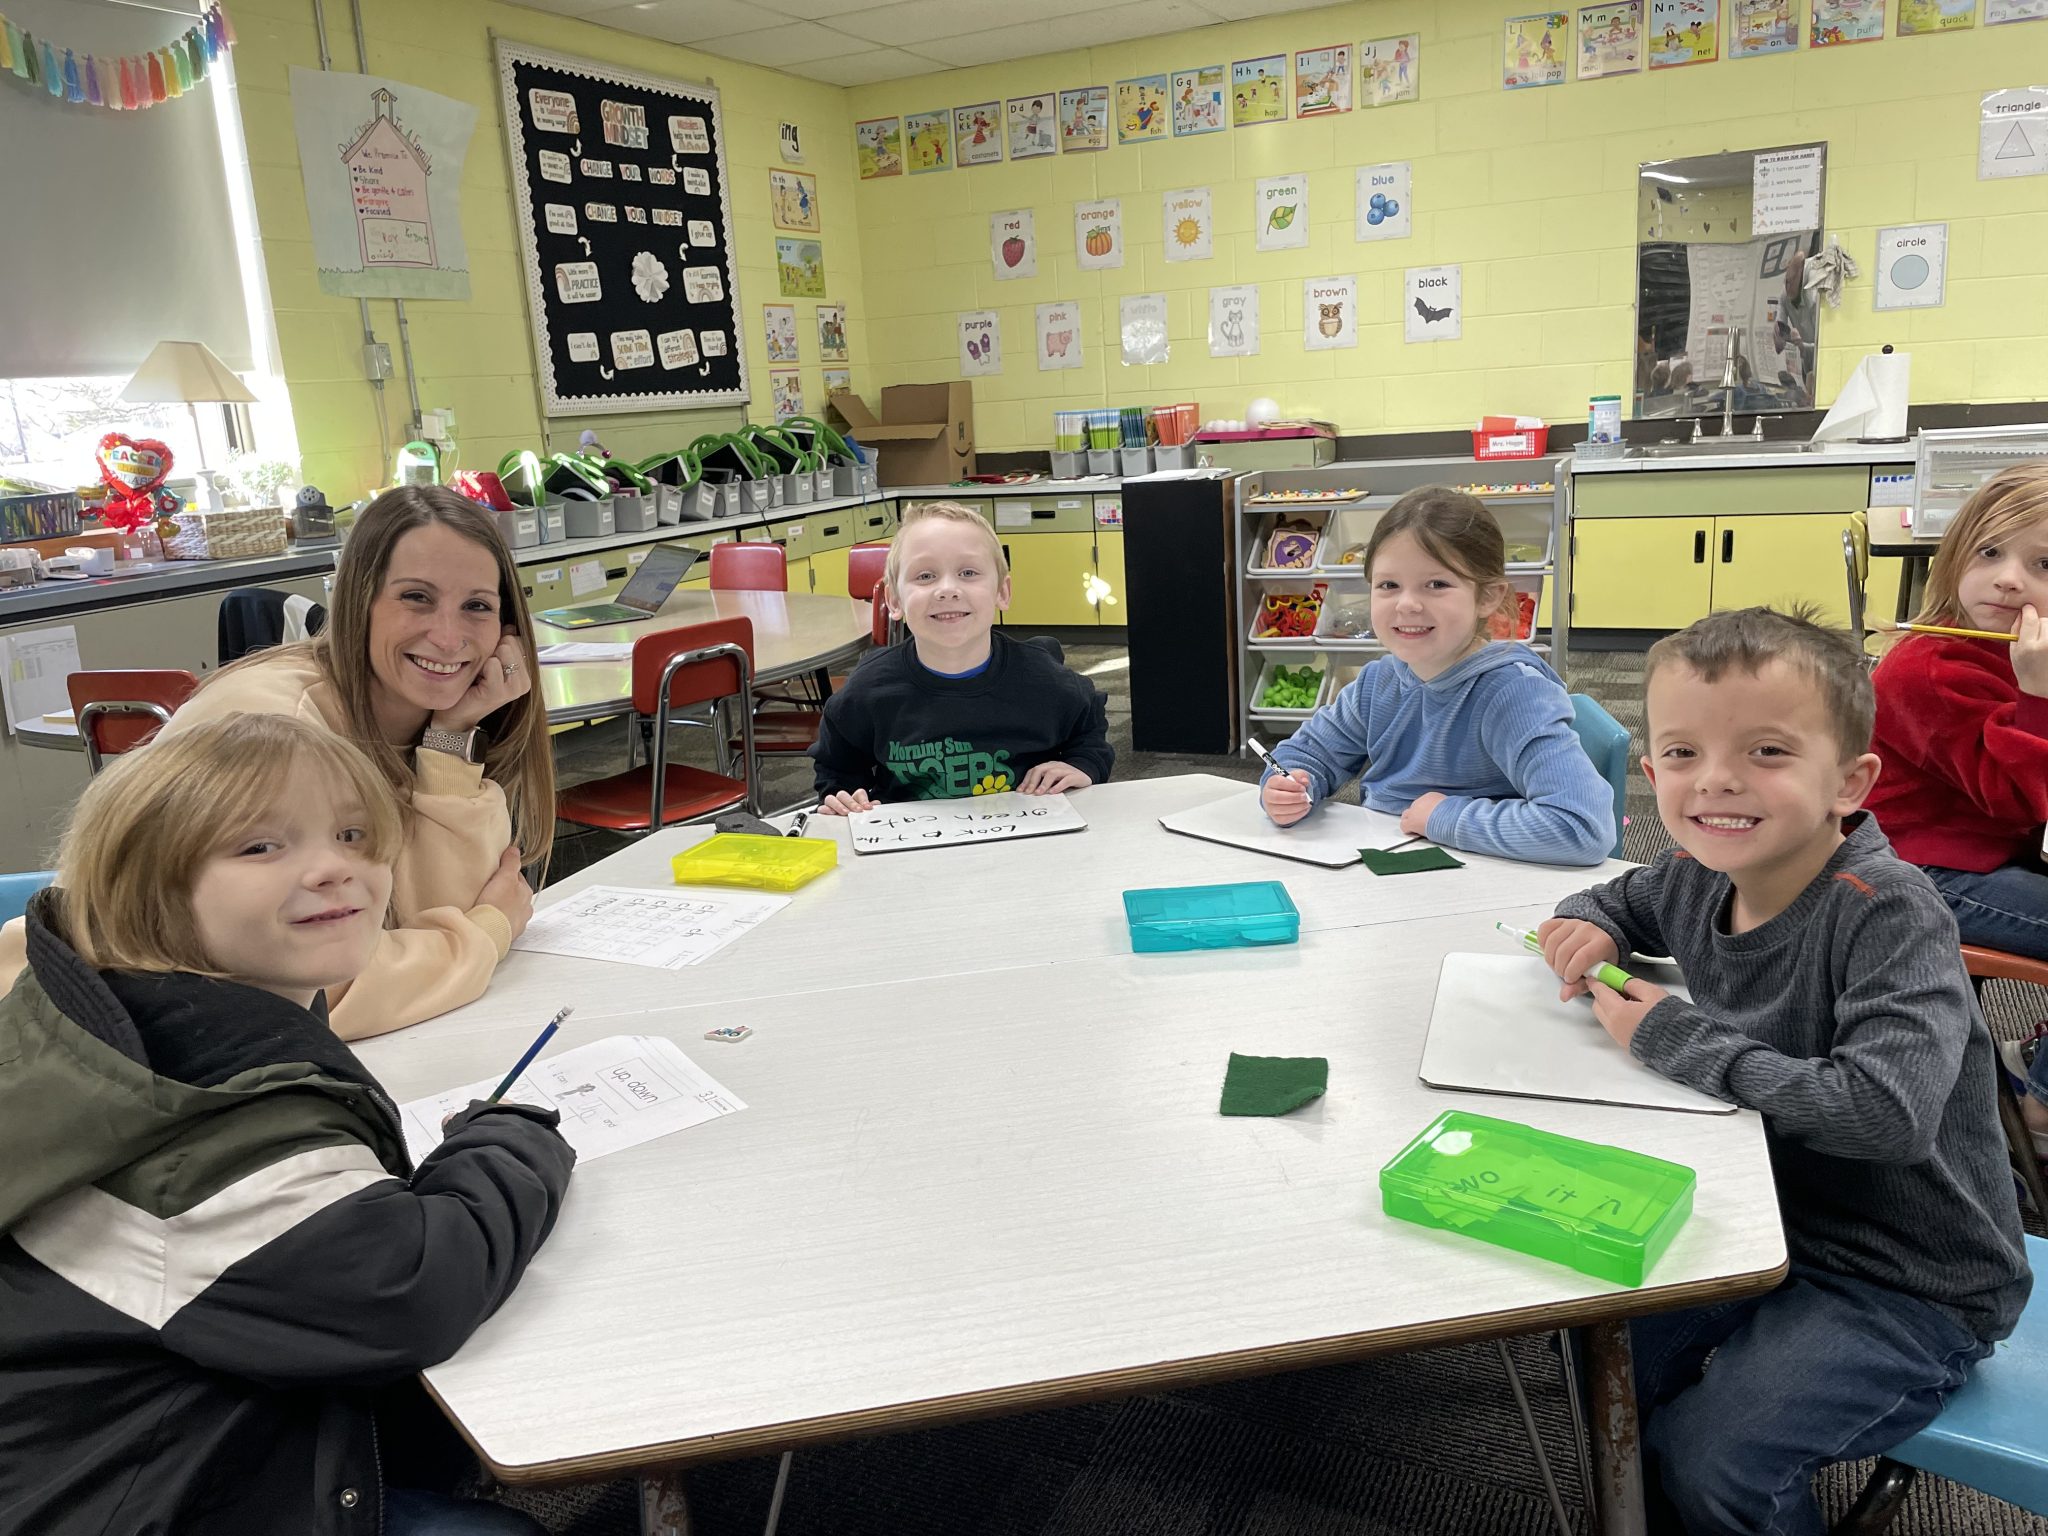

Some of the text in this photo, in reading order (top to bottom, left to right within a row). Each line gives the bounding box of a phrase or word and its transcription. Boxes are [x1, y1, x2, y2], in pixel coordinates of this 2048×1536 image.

[1655, 3, 1664, 14] N
[1583, 14, 1606, 24] M m
[1940, 14, 1969, 27] quack
[1856, 23, 1875, 37] puff
[1770, 38, 1782, 47] on
[1697, 48, 1711, 57] net
[1235, 68, 1243, 76] H
[1176, 78, 1183, 87] G
[534, 92, 570, 108] Everyone
[1395, 89, 1411, 99] jam
[1010, 105, 1017, 113] D
[1996, 100, 2042, 114] triangle
[602, 100, 645, 127] GROWTH
[1264, 109, 1278, 118] hop
[1150, 127, 1162, 135] fish
[1177, 121, 1199, 132] gurgle
[605, 122, 648, 147] MINDSET
[781, 123, 799, 152] ing
[1088, 138, 1101, 146] egg
[582, 160, 612, 176] CHANGE
[620, 164, 641, 180] YOUR
[649, 168, 675, 185] WORDS
[1371, 175, 1395, 186] blue
[1266, 186, 1297, 199] green
[1172, 199, 1203, 212] yellow
[586, 205, 682, 225] CHANGE YOUR MINDSET
[1081, 209, 1114, 221] orange
[1004, 220, 1020, 230] red
[1896, 237, 1927, 248] circle
[571, 278, 599, 290] PRACTICE
[1418, 276, 1448, 288] black
[1313, 287, 1348, 298] brown
[1222, 296, 1247, 308] gray
[1049, 312, 1067, 323] pink
[964, 320, 992, 331] purple
[889, 736, 973, 760] Morning Sun
[885, 750, 1015, 797] TIGERS
[576, 897, 618, 917] much
[623, 898, 717, 914] ch ch ch ch
[680, 928, 704, 937] ch
[627, 1081, 658, 1103] down
[1453, 1170, 1500, 1193] wo
[1546, 1184, 1577, 1204] it
